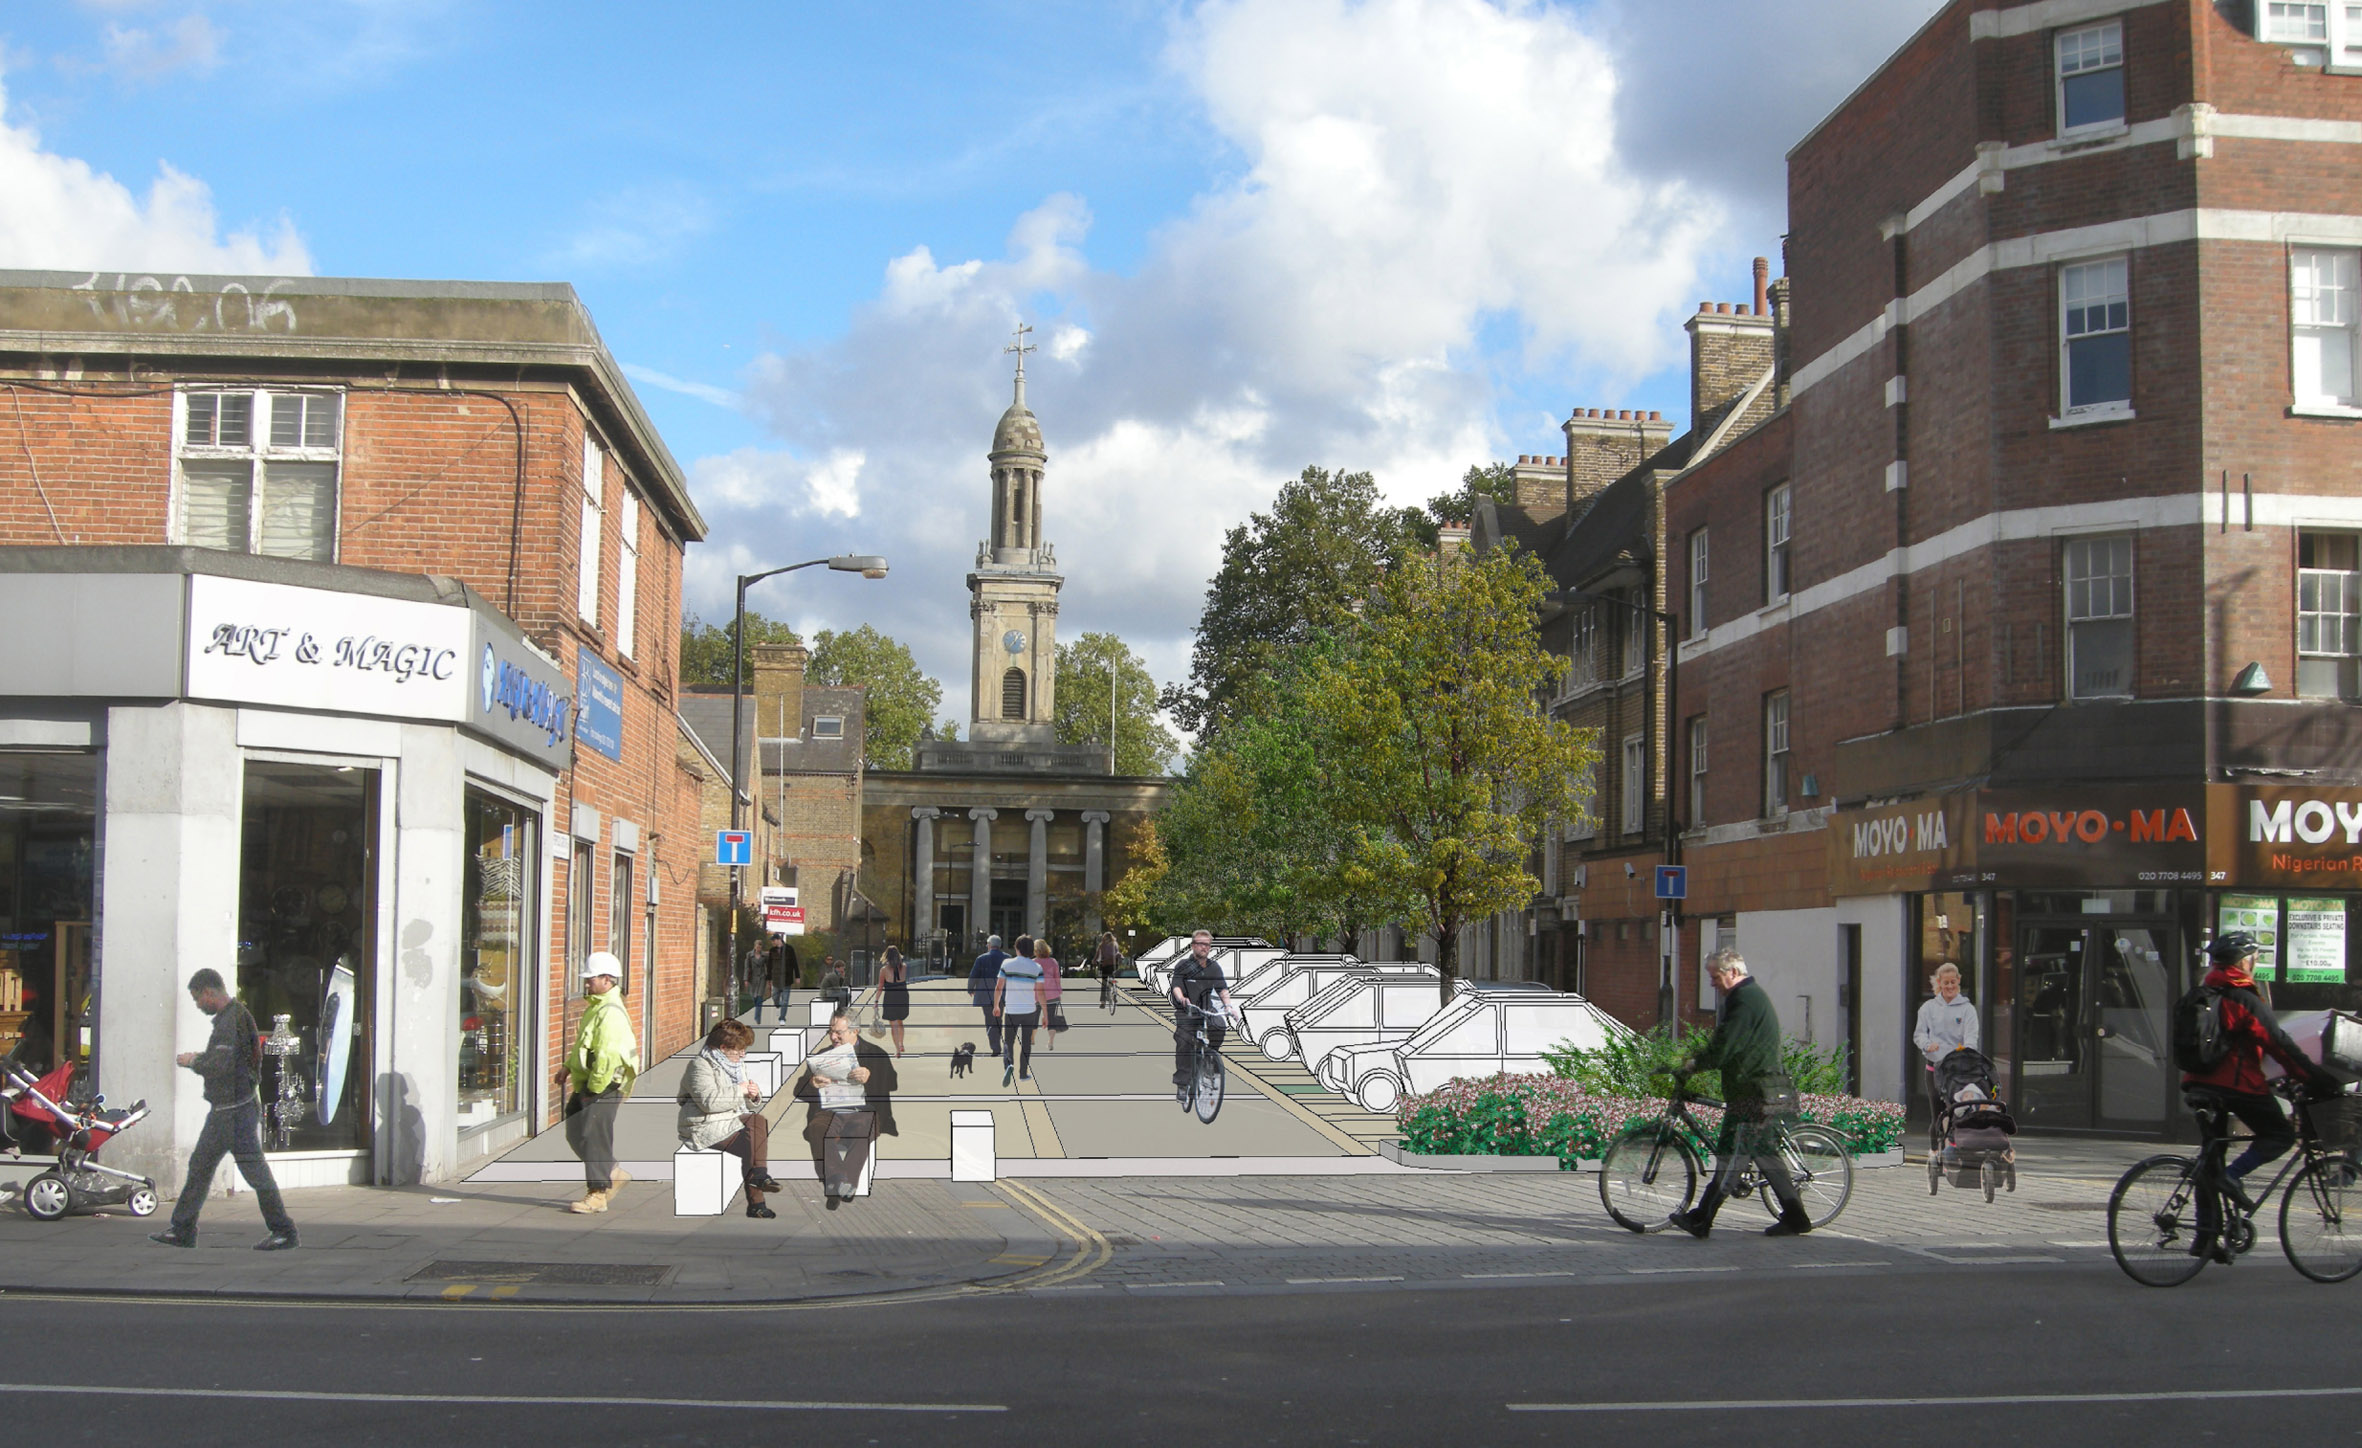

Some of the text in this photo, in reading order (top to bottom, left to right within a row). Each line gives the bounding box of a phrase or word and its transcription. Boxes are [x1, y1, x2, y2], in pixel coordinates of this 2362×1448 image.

[204, 623, 456, 683] ART & MAGIC
[1984, 807, 2197, 844] MOYO MA
[2249, 799, 2362, 844] MOY
[1853, 810, 1948, 859] MOYO MA
[2272, 853, 2348, 872] Nigerian
[1981, 872, 1996, 881] 347
[2138, 872, 2202, 880] 020 7708 4495
[2210, 871, 2226, 880] 347
[2288, 922, 2344, 930] DOWNSTAIRS SEATING
[2323, 974, 2339, 982] 4495
